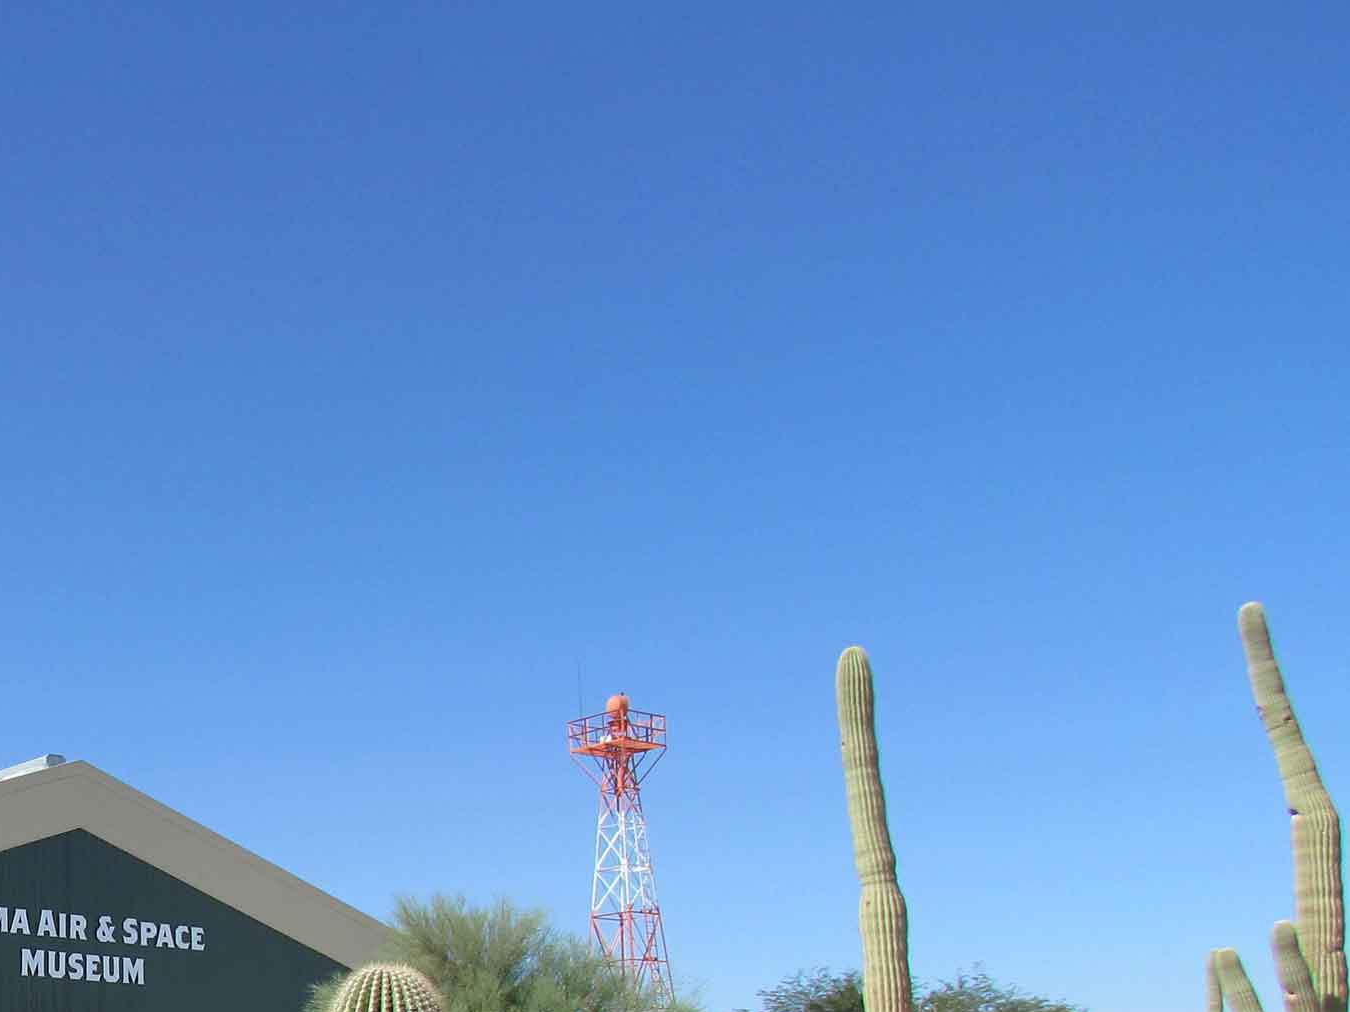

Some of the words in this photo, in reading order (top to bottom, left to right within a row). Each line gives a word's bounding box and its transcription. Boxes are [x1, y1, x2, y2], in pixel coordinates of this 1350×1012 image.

[36, 909, 87, 940] AIR
[96, 915, 117, 943] &
[122, 918, 206, 951] SPACE
[21, 948, 145, 985] MUSEUM
